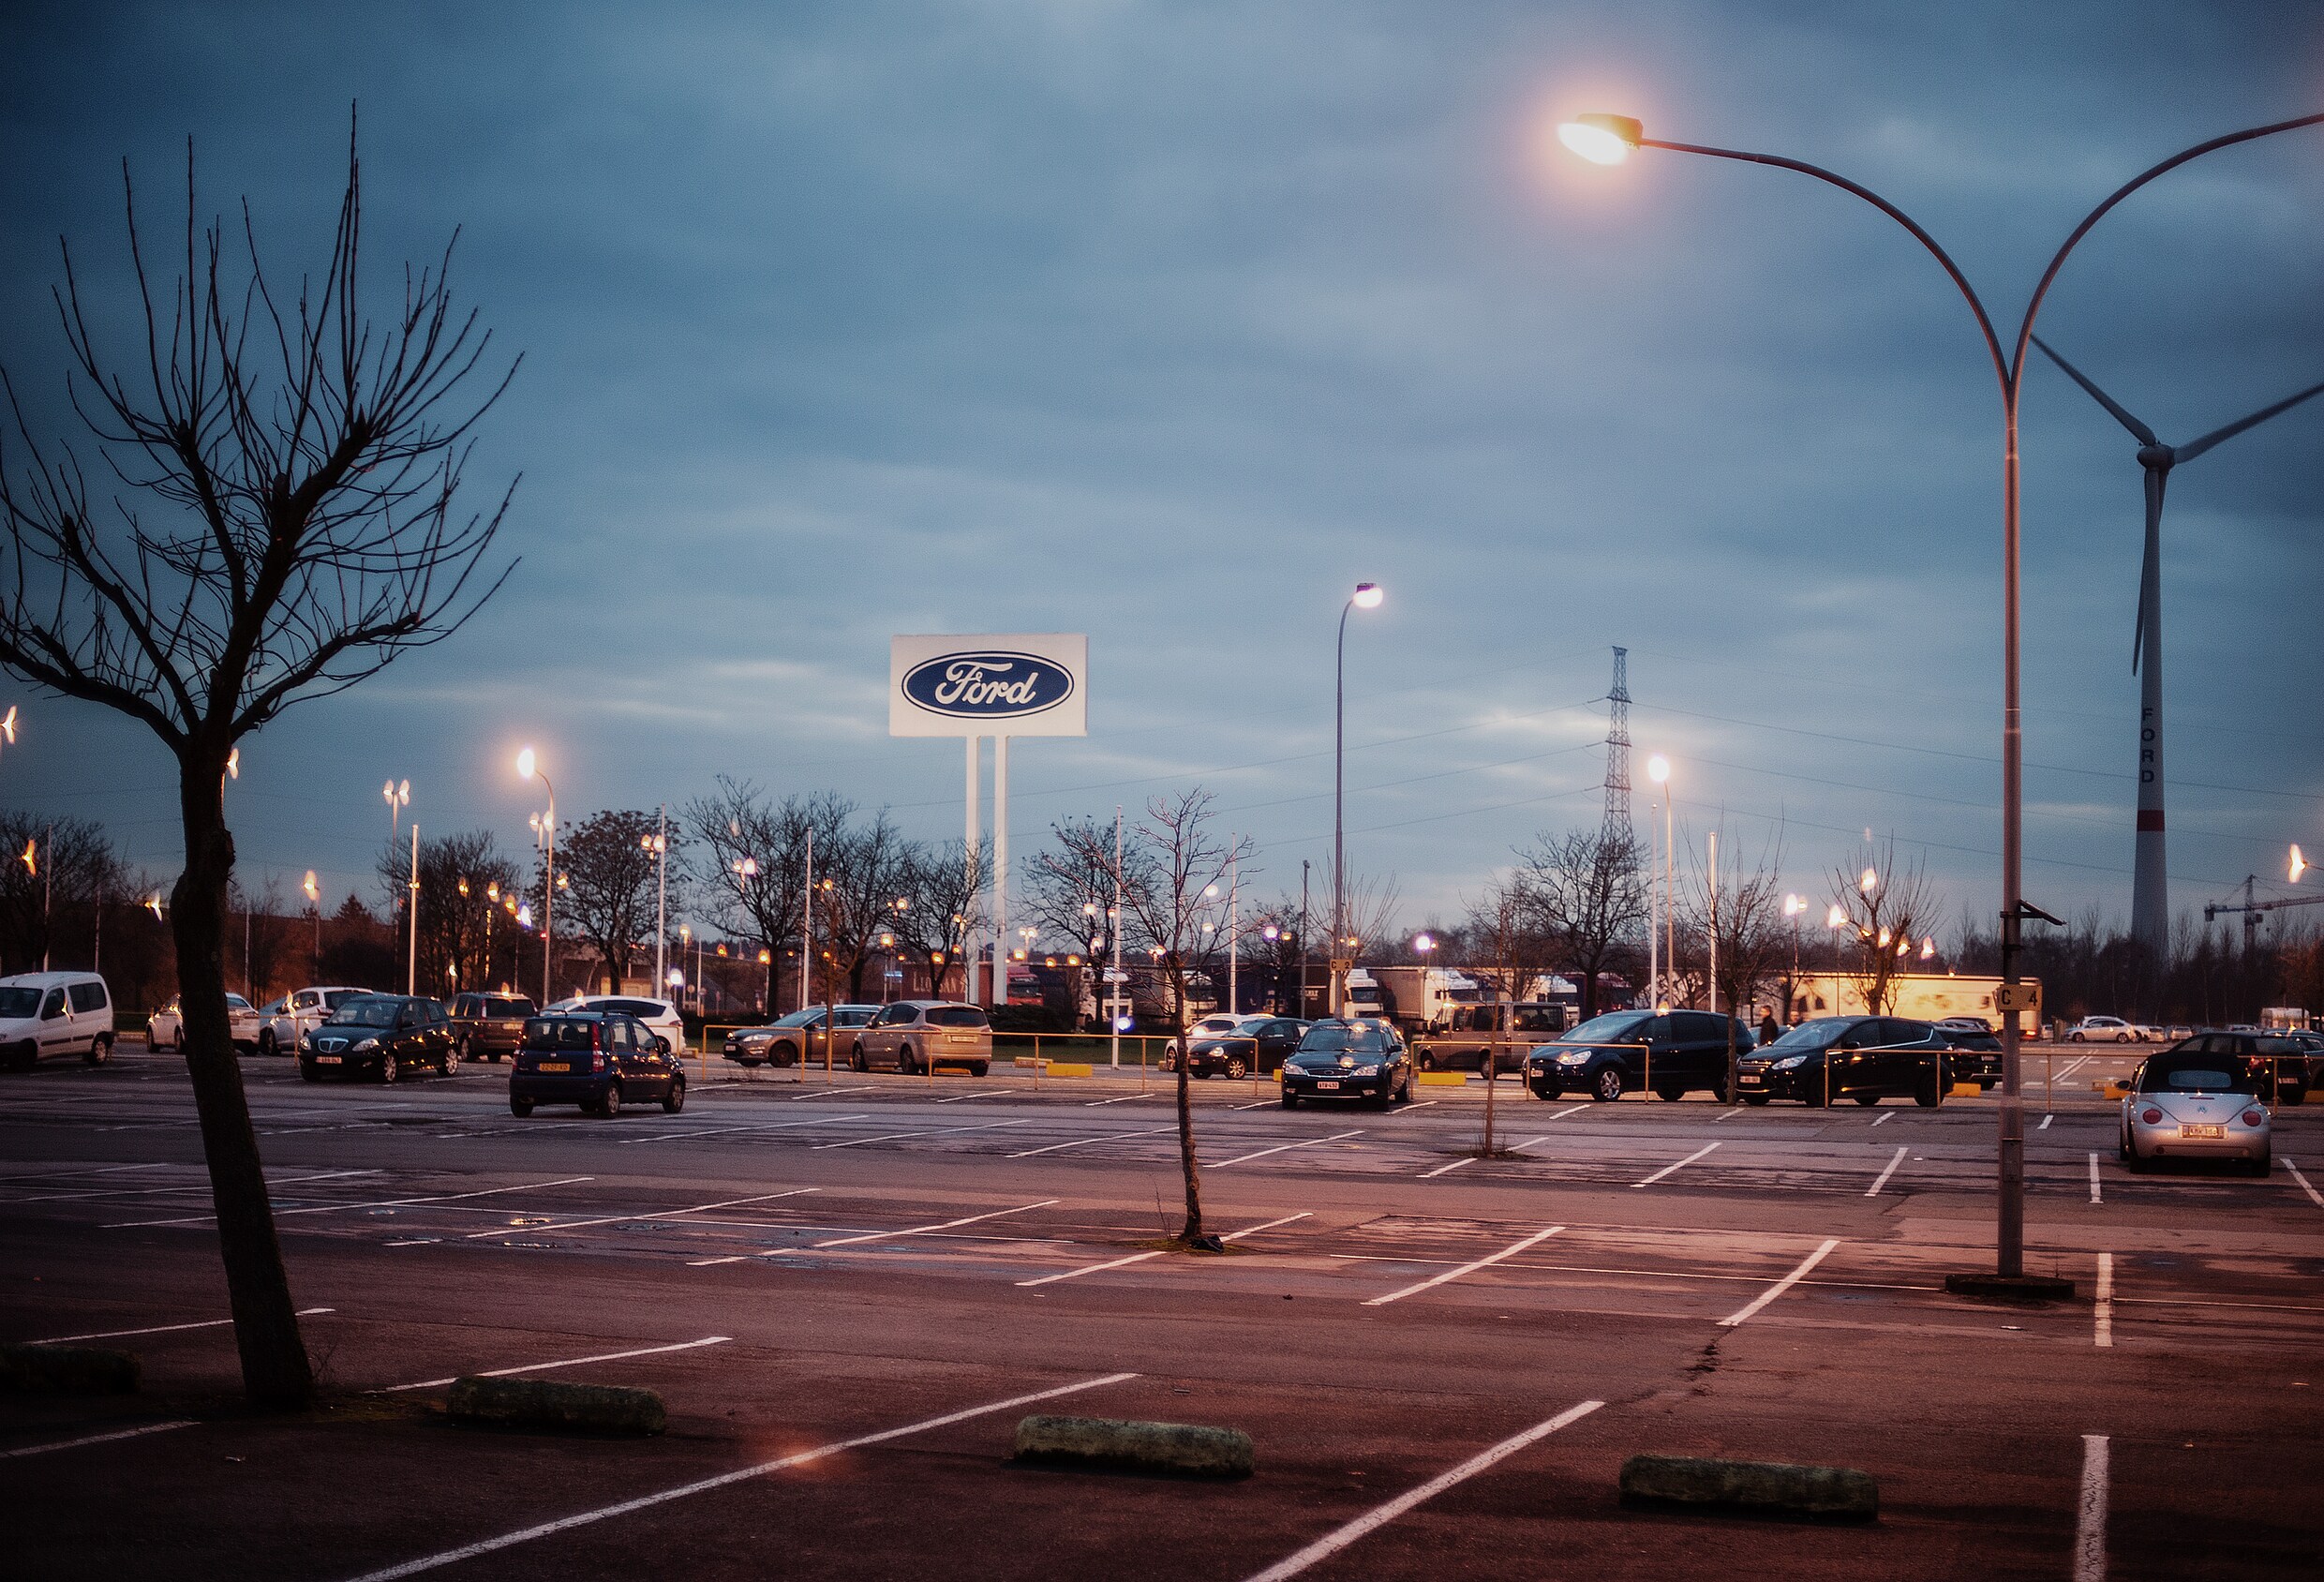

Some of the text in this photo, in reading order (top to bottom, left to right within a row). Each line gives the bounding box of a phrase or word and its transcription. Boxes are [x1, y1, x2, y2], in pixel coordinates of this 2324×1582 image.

[935, 661, 1039, 705] Ford
[2140, 708, 2155, 784] FORD
[2002, 990, 2038, 1007] C 4
